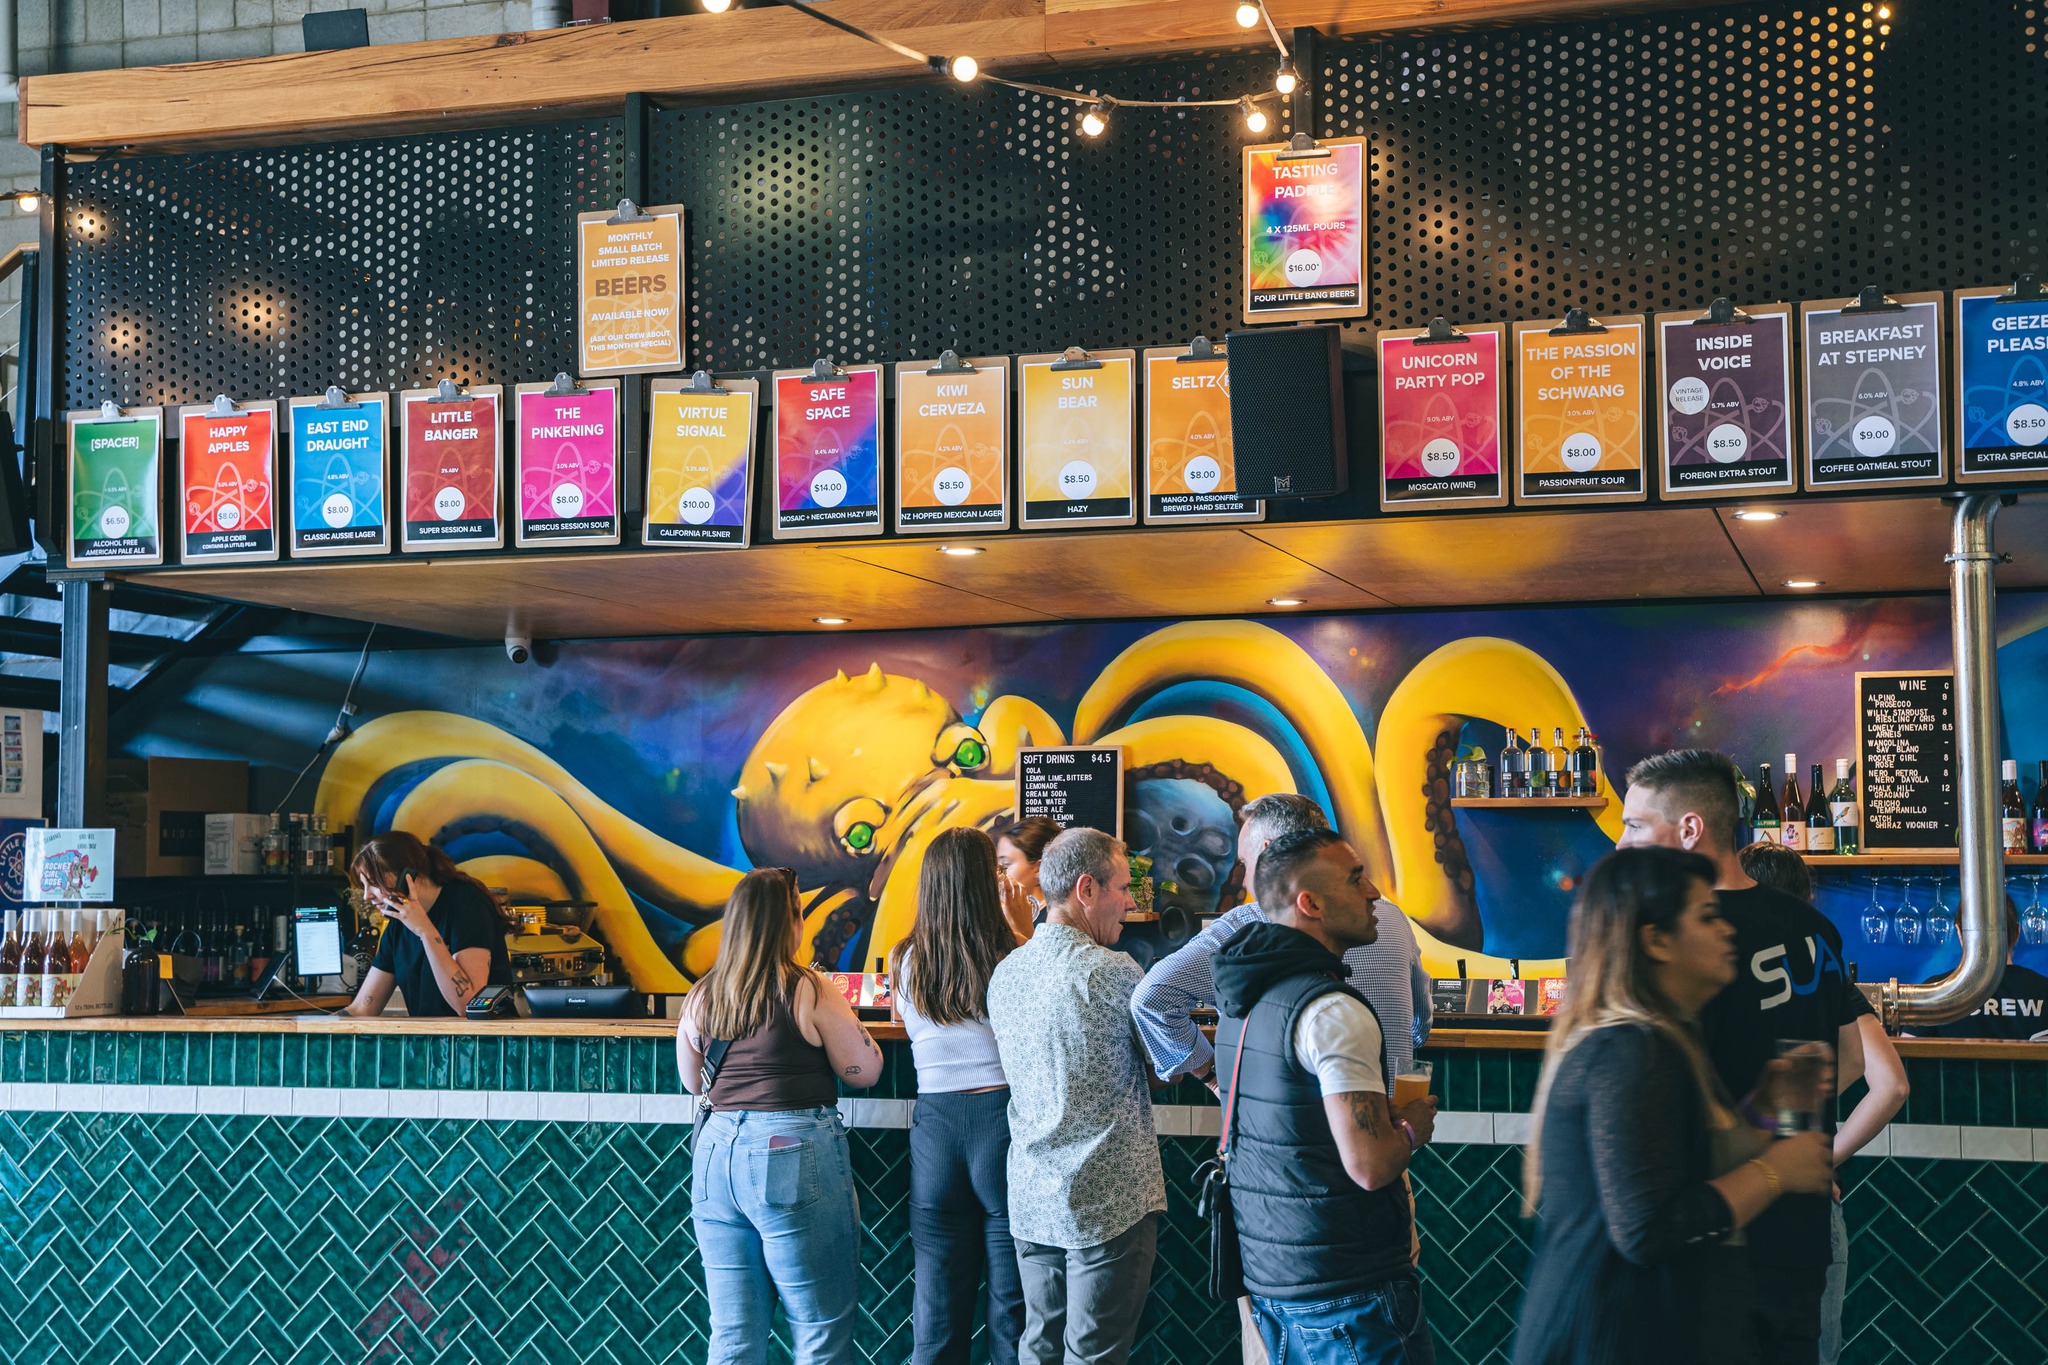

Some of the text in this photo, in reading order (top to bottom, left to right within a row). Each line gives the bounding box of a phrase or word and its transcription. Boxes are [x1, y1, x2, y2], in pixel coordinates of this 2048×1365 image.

[1272, 163, 1338, 179] TASTING
[1283, 224, 1311, 233] 125ML
[1314, 222, 1345, 230] POURS
[608, 232, 653, 242] MONTHLY
[599, 243, 662, 255] SMALL BATCH
[592, 254, 669, 267] LIMITED RELEASE
[596, 275, 666, 296] BEERS
[1278, 293, 1303, 301] LITTLE
[1330, 290, 1354, 298] BEERS
[592, 308, 669, 321] AVAILABLE NOW!
[1992, 315, 2048, 331] GEEZE
[608, 333, 622, 341] OUR
[646, 330, 670, 338] ABOUT
[1820, 325, 1924, 345] BREAKFAST
[1696, 334, 1752, 351] INSIDE
[1988, 335, 2048, 353] PLEAS
[1526, 343, 1635, 360] THE PASSION
[1818, 345, 1926, 366] AT STEPNEY
[1402, 353, 1478, 369] UNICORN
[1698, 355, 1751, 371] VOICE
[1551, 365, 1611, 379] OF THE
[1062, 377, 1093, 390] SUN
[1395, 372, 1485, 389] PARTY POP
[810, 388, 845, 401] SAFE
[937, 385, 967, 396] KIWI
[1538, 385, 1624, 400] SCHWANG
[1058, 396, 1097, 409] BEAR
[555, 407, 580, 419] THE
[679, 407, 727, 419] VIRTUE
[806, 406, 850, 420] SPACE
[919, 402, 985, 416] CERVEZA
[431, 411, 472, 423] LITTLE
[307, 420, 368, 434] EAST END
[2014, 419, 2045, 429] $8.50
[210, 426, 247, 438] HAPPY
[425, 428, 478, 441] BANGER
[531, 424, 604, 439] PINKENING
[676, 426, 726, 437] SIGNAL
[1859, 430, 1889, 440] $9.00
[91, 437, 139, 451] [SPACER]
[208, 441, 249, 454] APPLES
[307, 437, 368, 452] DRAUGHT
[1713, 439, 1741, 448] $8.50
[1427, 452, 1455, 461] $8.50
[1567, 448, 1596, 457] $8.00
[1977, 451, 2048, 462] EXTRA SPECIAL
[1820, 460, 1931, 473] COFFEE OATMEAL STOUT
[1065, 475, 1090, 483] $8.50
[1190, 471, 1215, 479] $8.00
[1680, 467, 1777, 480] FOREIGN EXTRA STOUT
[814, 483, 841, 492] $14.00
[939, 481, 964, 489] $8.50
[1408, 481, 1476, 491] MOSCATO (WINE)
[1539, 477, 1625, 487] PASSIONFRUIT SOUR
[440, 500, 460, 508] $8.00
[556, 496, 579, 504] $8.00
[683, 501, 709, 509] $10.00
[328, 506, 348, 514] $8.00
[1067, 505, 1088, 513] HAZY
[1163, 504, 1192, 512] BREWED
[106, 517, 125, 525] $6.50
[218, 512, 238, 520] $8.00
[811, 512, 845, 520] NECTARON
[702, 530, 730, 538] PILSNER
[1900, 681, 1926, 690] WINE
[1875, 700, 1911, 708] PROSECCO
[1024, 754, 1111, 764] SOFT DRINKS $4.5
[1969, 999, 2044, 1017] REW
